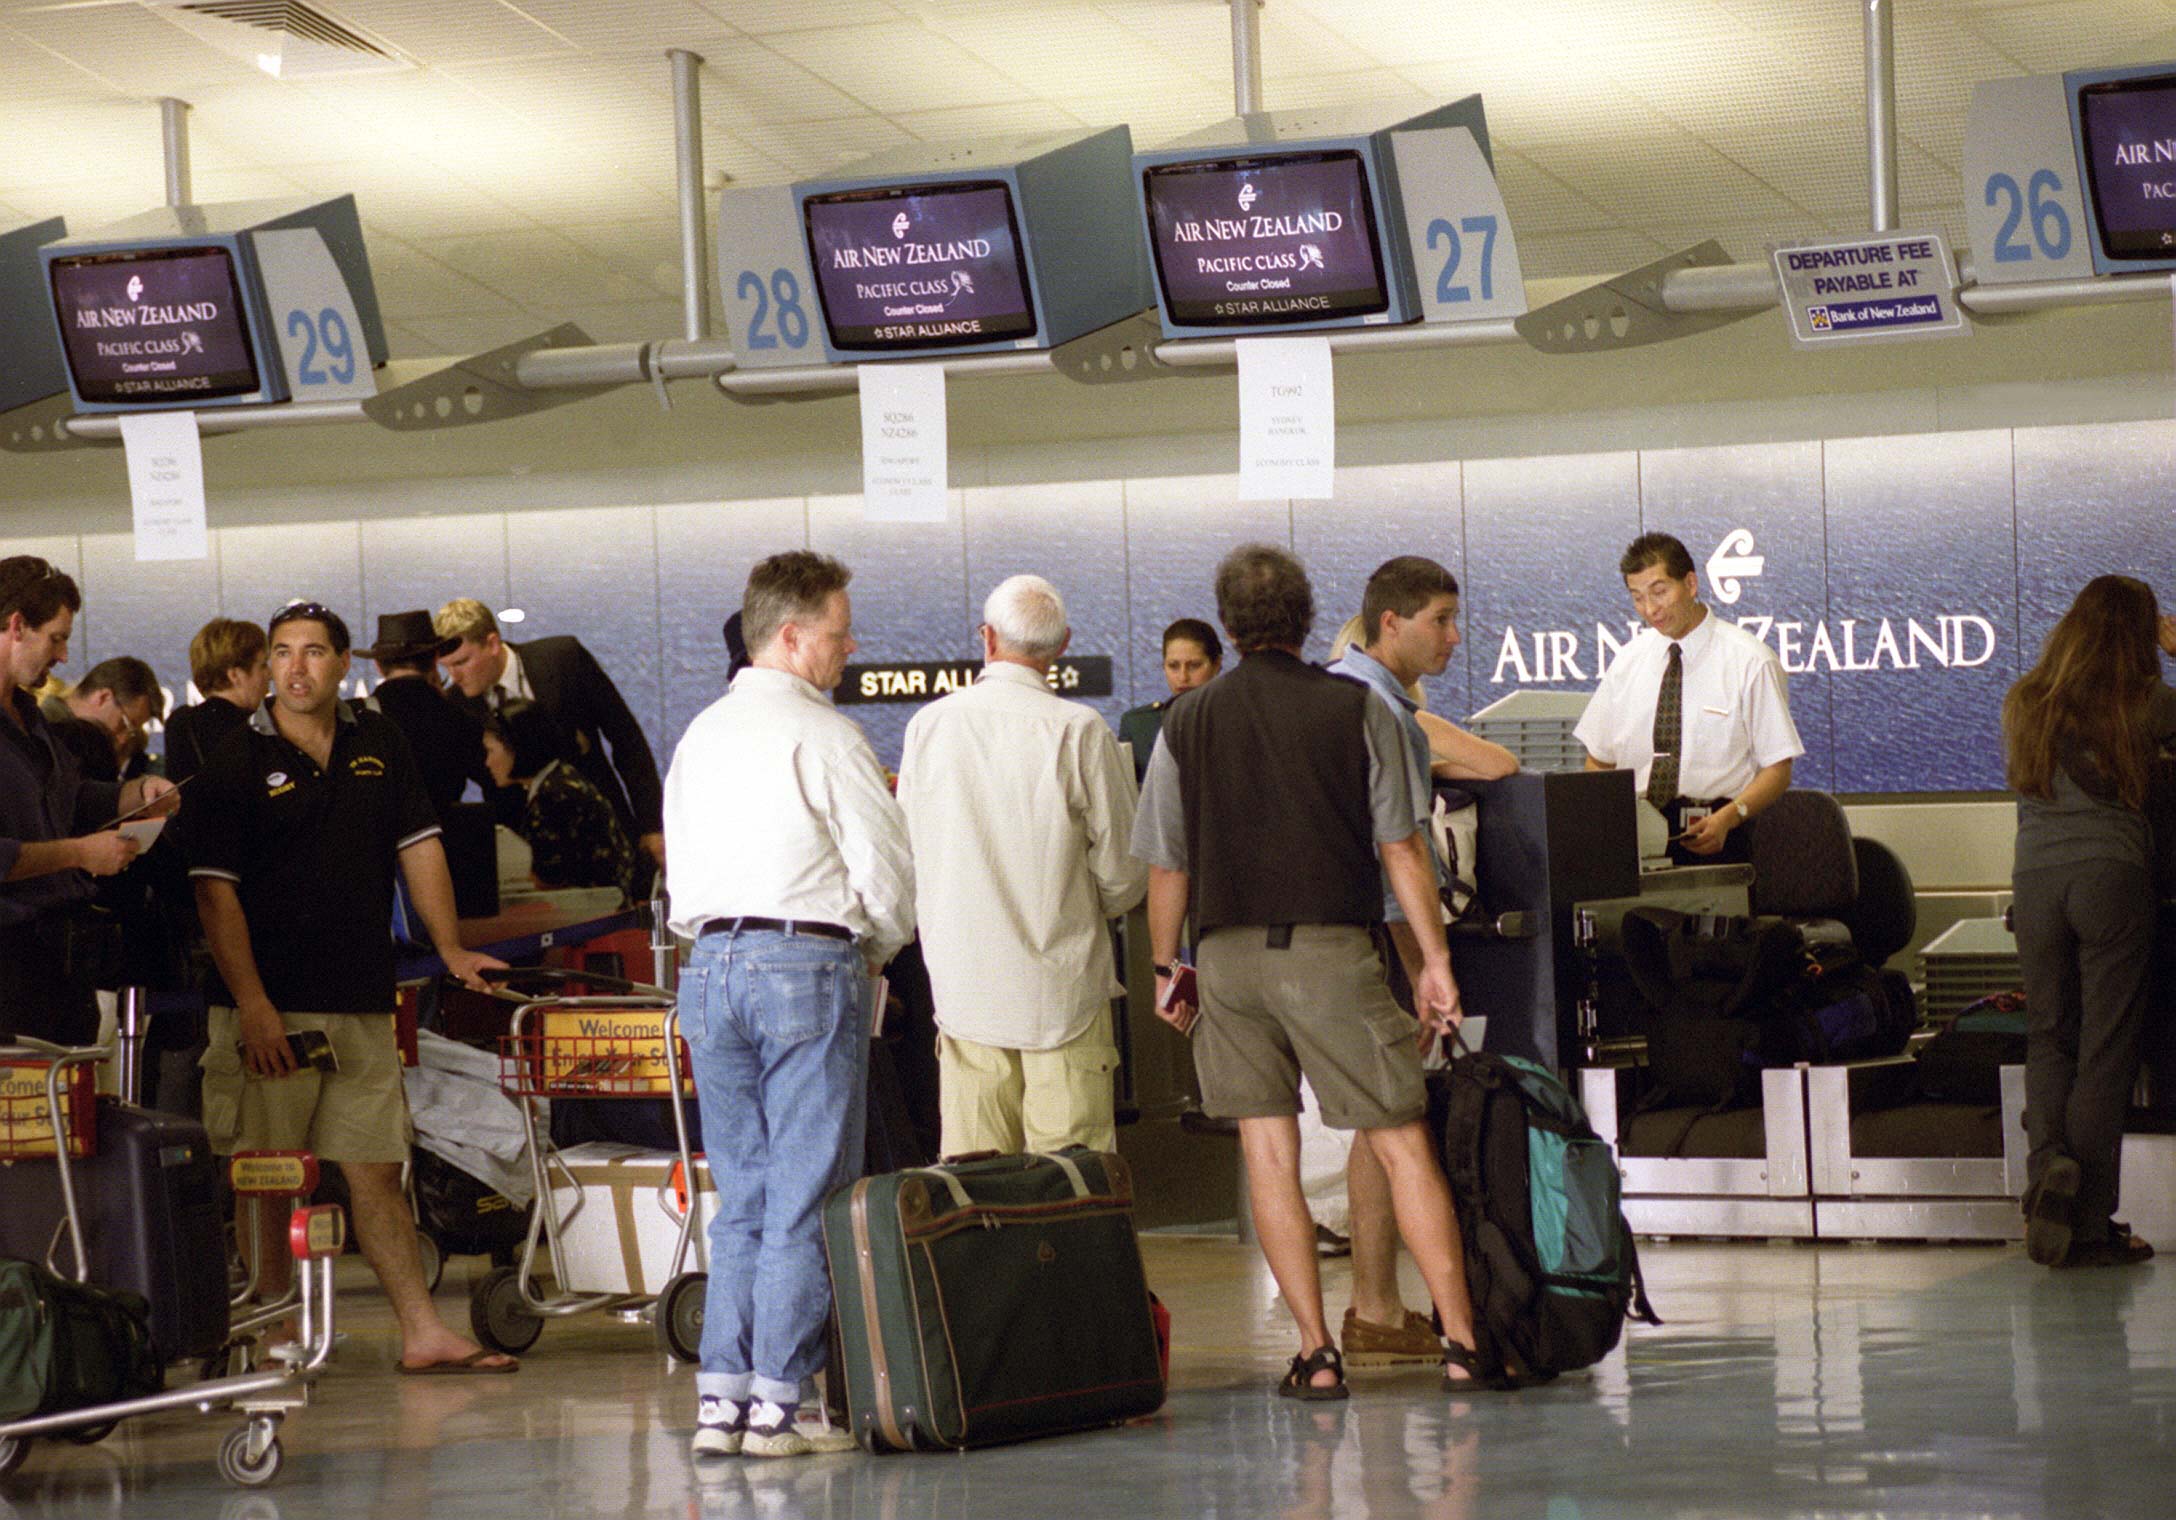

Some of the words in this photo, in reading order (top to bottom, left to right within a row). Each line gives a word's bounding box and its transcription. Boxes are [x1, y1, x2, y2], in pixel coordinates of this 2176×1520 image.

[2115, 143, 2151, 166] AIR
[1173, 220, 1204, 243] AIR
[1205, 218, 1248, 241] NEW
[1251, 211, 1343, 239] ZEALAND
[1985, 169, 2071, 263] 26
[833, 248, 863, 269] AIR
[863, 245, 902, 267] NEW
[906, 238, 991, 265] ZEALAND
[1197, 254, 1253, 274] PACIFIC
[1255, 252, 1297, 271] CLASS
[1427, 214, 1497, 304] 27
[1788, 244, 1893, 271] DEPARTURE
[1898, 241, 1933, 260] FEE
[856, 281, 907, 300] PACIFIC
[910, 280, 949, 297] CLASS
[1226, 280, 1259, 293] Counter
[1260, 277, 1290, 290] Closed
[1814, 270, 1893, 296] PAYABLE
[1897, 268, 1919, 287] AT
[76, 307, 101, 329] AIR
[99, 306, 136, 328] NEW
[138, 301, 217, 325] ZEALAND
[737, 267, 810, 350] 28
[915, 302, 944, 315] Closed
[1226, 300, 1262, 315] STAR
[1263, 295, 1331, 313] ALLIANCE
[1831, 306, 1856, 324] Bank
[1857, 306, 1870, 321] of
[1871, 303, 1895, 322] New
[1895, 300, 1937, 319] Zealand
[884, 326, 917, 340] STAR
[918, 320, 982, 338] ALLIANCE
[97, 340, 144, 356] PACIFIC
[145, 338, 180, 355] CLASS
[287, 307, 356, 386] 29
[123, 379, 153, 394] STAR
[153, 376, 211, 392] ALLIANCE
[1490, 625, 1588, 683] AIR
[1736, 614, 1996, 673] ZEALAND
[860, 670, 927, 697] STAR
[578, 1019, 660, 1038] Welcome
